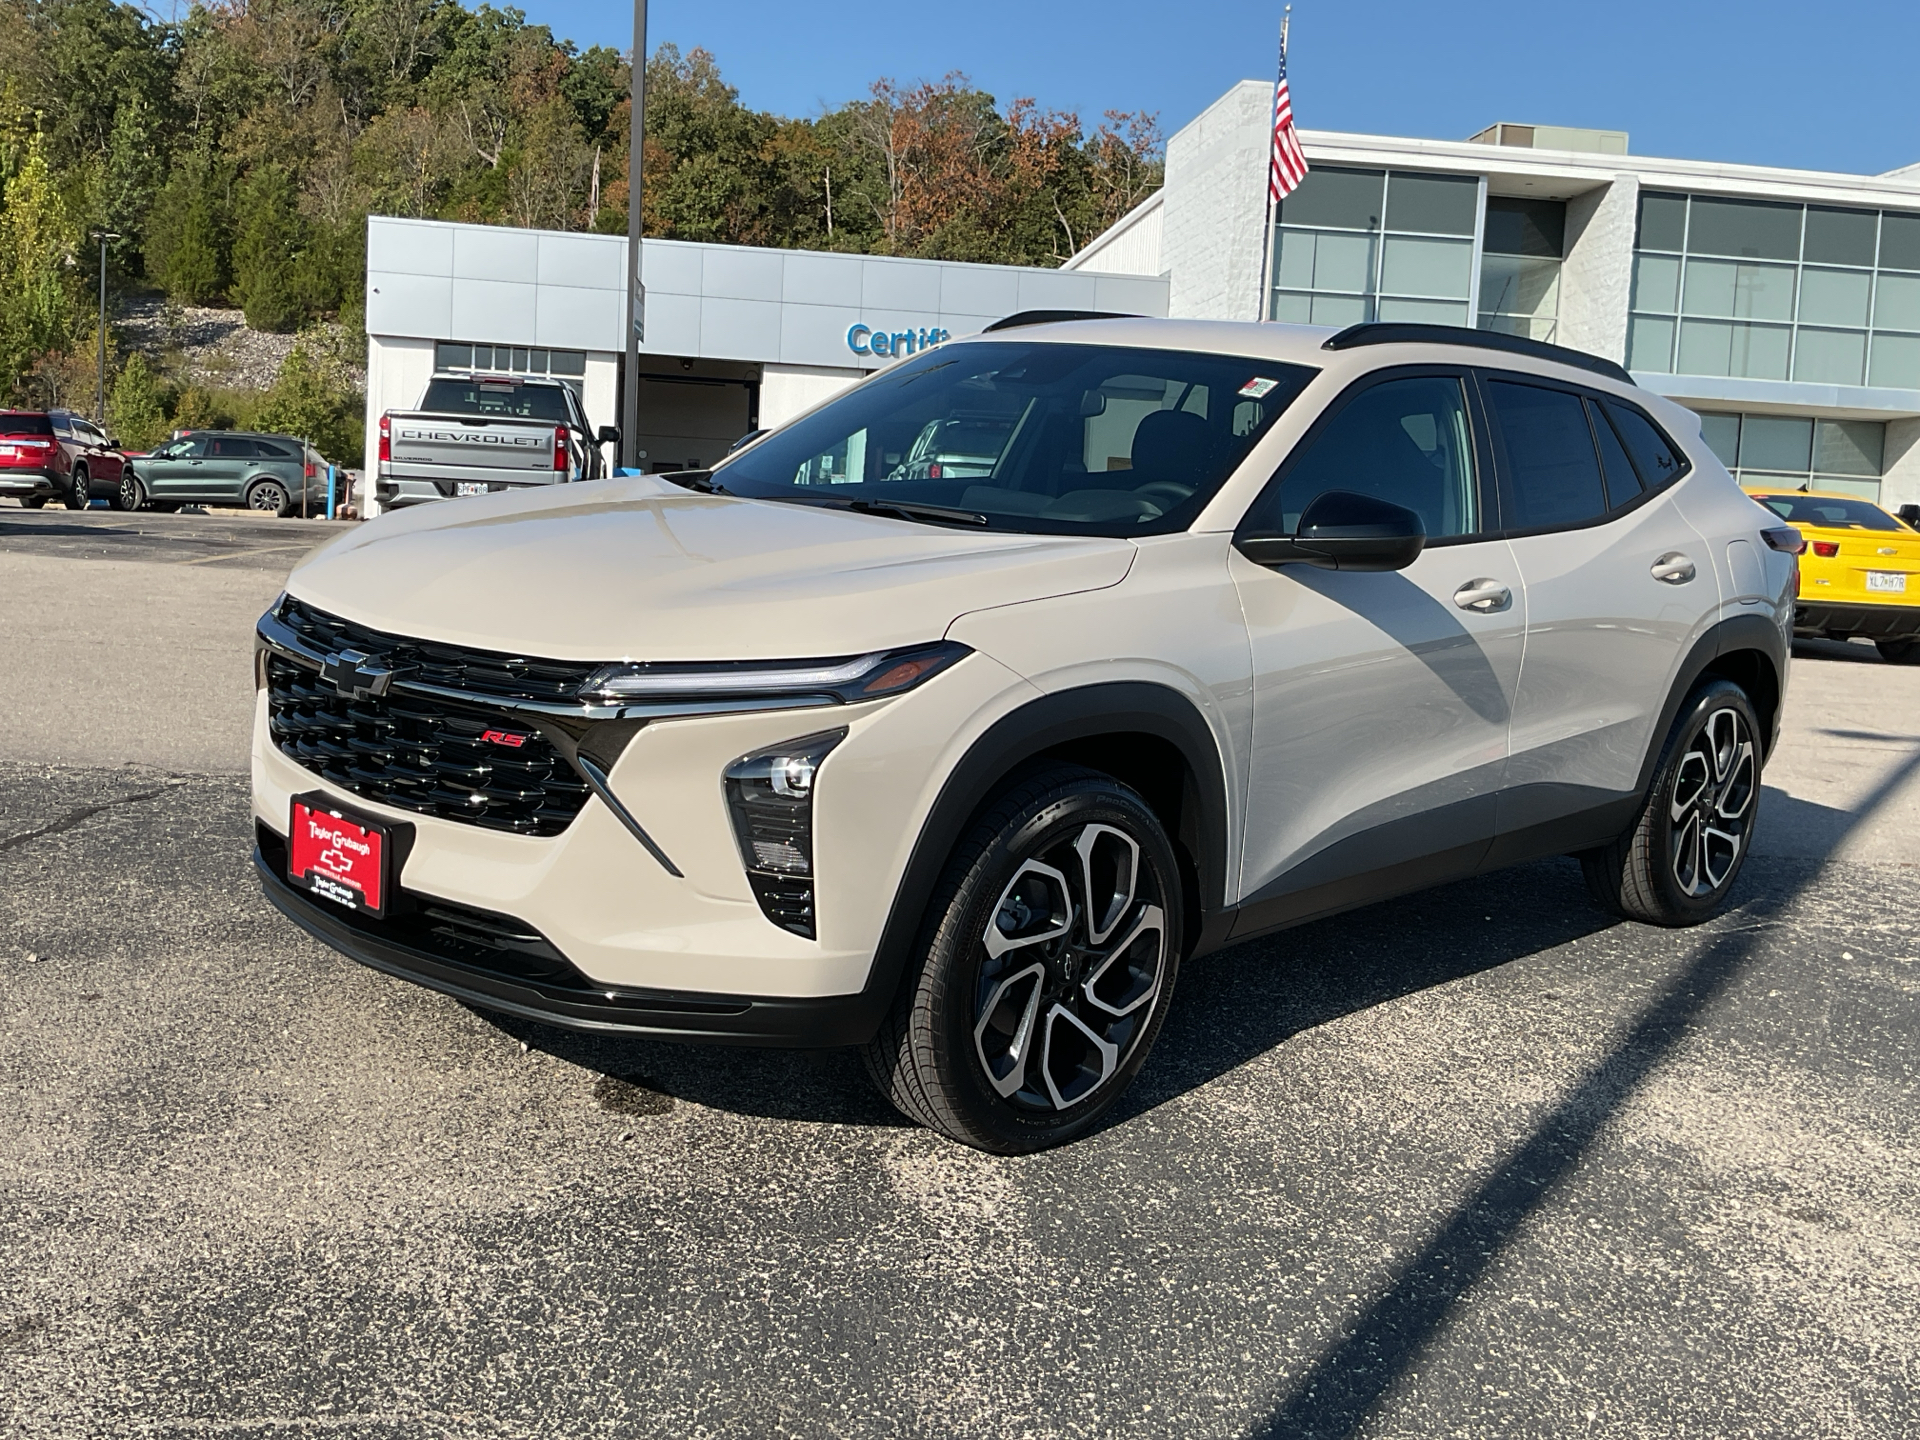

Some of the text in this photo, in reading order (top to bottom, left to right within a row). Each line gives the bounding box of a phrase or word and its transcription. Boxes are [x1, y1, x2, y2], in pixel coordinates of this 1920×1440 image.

[402, 430, 544, 447] CHEVROLET
[481, 730, 526, 748] RS
[308, 820, 370, 856] Taylor Grubaugh
